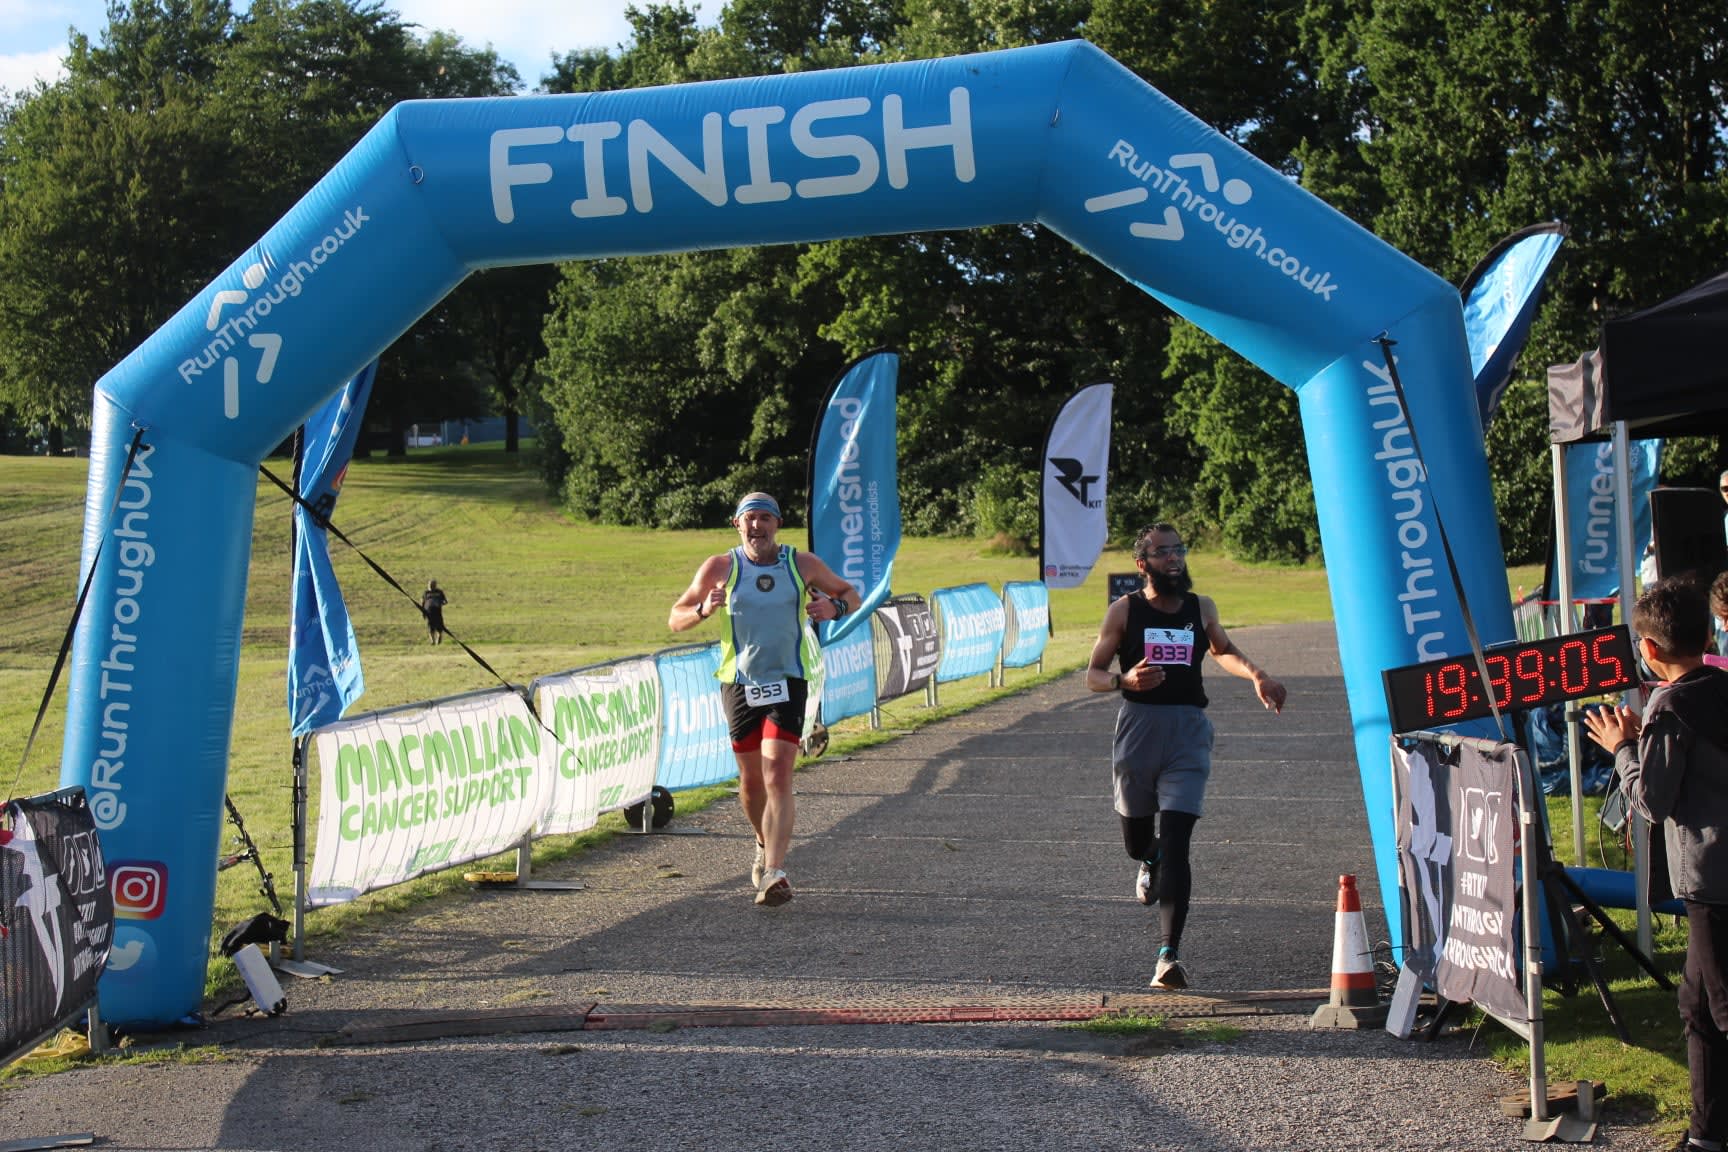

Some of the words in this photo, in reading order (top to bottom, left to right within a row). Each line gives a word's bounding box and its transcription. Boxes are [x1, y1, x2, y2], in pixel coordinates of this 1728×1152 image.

[489, 87, 977, 224] FINISH
[1107, 138, 1339, 302] RunThrough.co.uk
[178, 205, 371, 385] RunThrough.co.uk
[866, 481, 882, 541] specialists
[89, 443, 156, 830] @RunThroughUK
[1152, 645, 1187, 660] 833
[555, 676, 656, 745] MACMILLAN
[750, 684, 782, 700] 953
[335, 715, 541, 803] MACMILLAN
[559, 739, 618, 780] CANCER
[617, 725, 654, 766] SUPPORT
[340, 789, 439, 842] CANCER
[442, 766, 533, 819] SUPPORT
